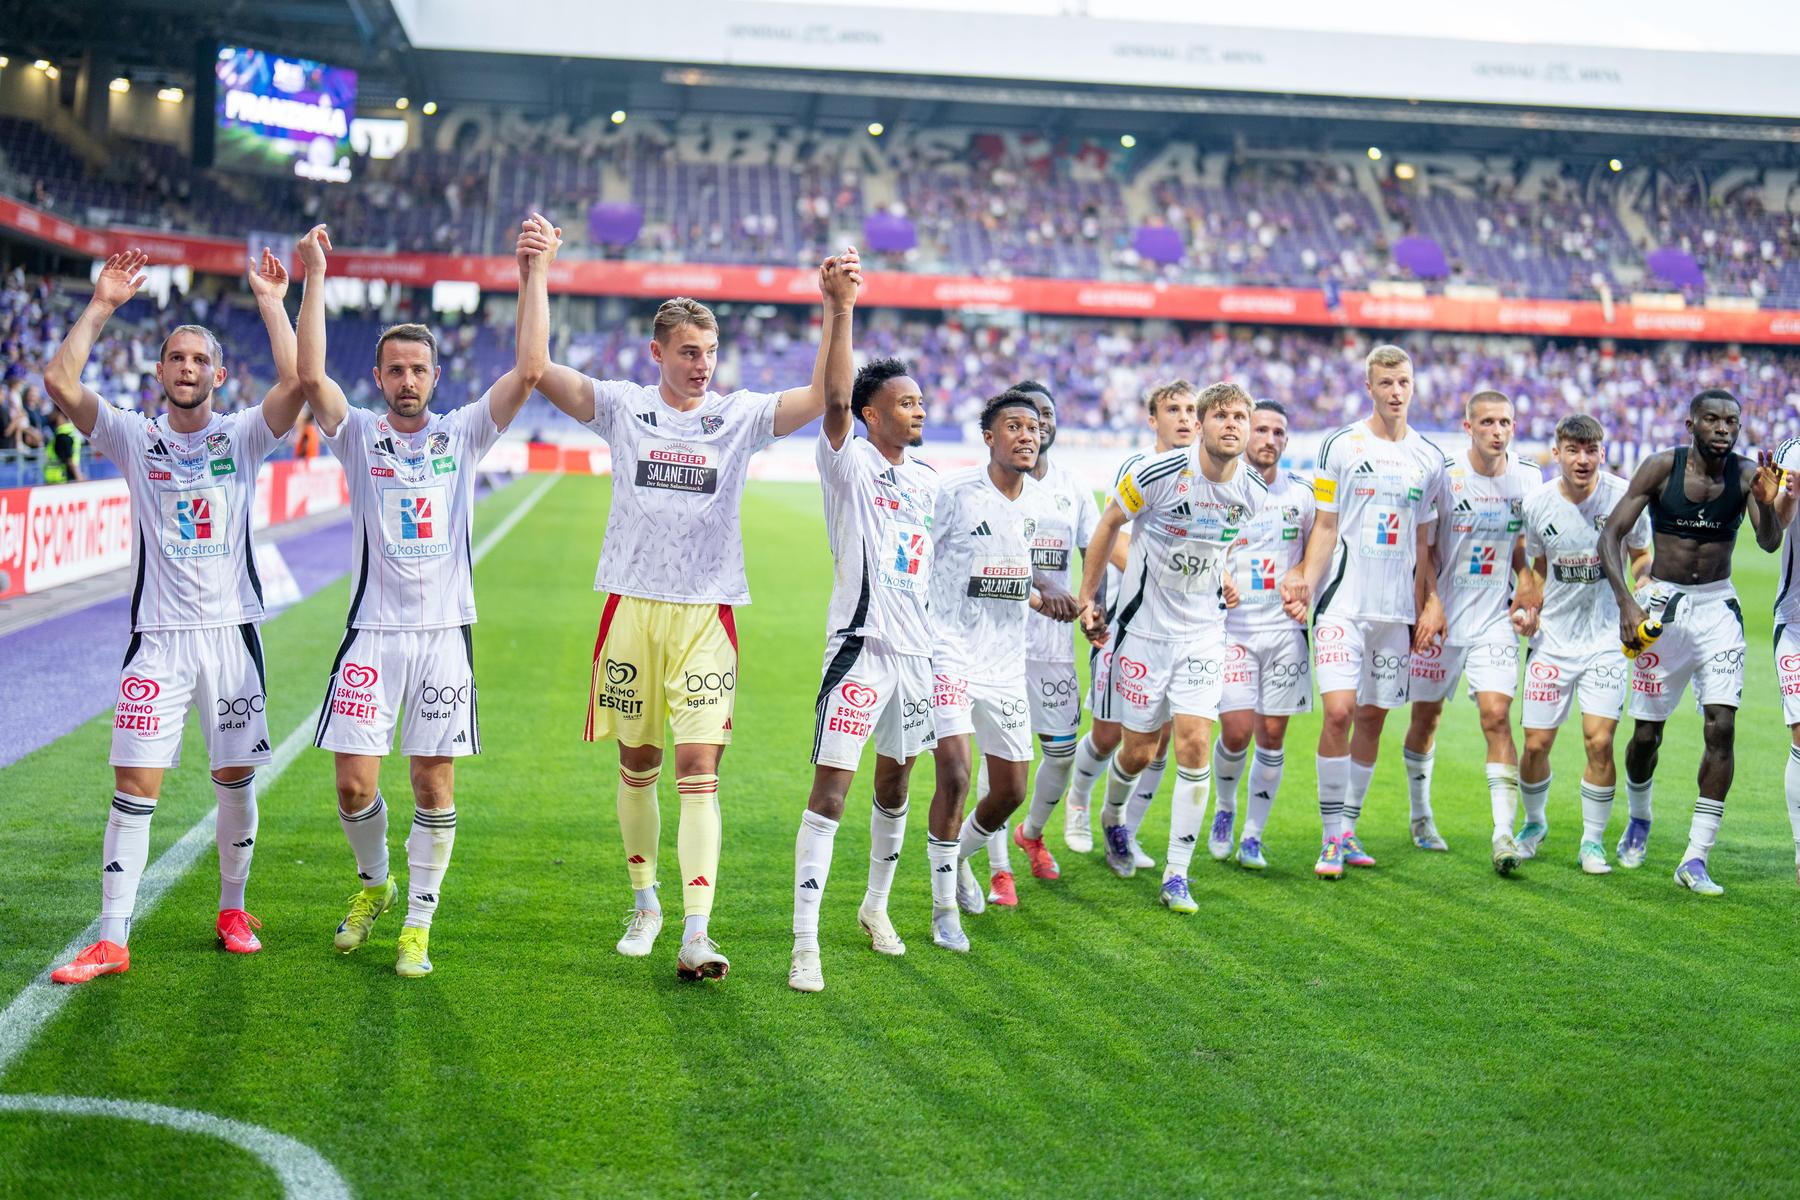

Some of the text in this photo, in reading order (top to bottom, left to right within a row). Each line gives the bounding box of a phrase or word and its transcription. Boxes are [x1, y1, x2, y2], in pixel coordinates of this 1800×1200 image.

[652, 451, 704, 465] SORGER
[371, 468, 386, 476] ORF
[647, 463, 705, 486] SALANETTIS
[1676, 518, 1722, 529] CATAPULT
[32, 498, 131, 572] SPORTWETTE
[163, 542, 227, 557] Ökostrom
[985, 567, 1029, 576] SORGER
[1224, 671, 1252, 684] SZEIT
[1411, 668, 1446, 680] ISZEIT
[1632, 679, 1663, 694] SZEIT
[337, 687, 372, 703] ESKIMO
[117, 701, 154, 715] ESKIMO
[332, 699, 377, 720] EISZEIT
[686, 697, 718, 709] bgd.at
[421, 709, 451, 721] bgd.at
[837, 706, 870, 722] ESKIMO
[114, 715, 160, 731] ISZEIT
[219, 720, 246, 733] gd.at
[828, 717, 872, 739] EISZEIT
